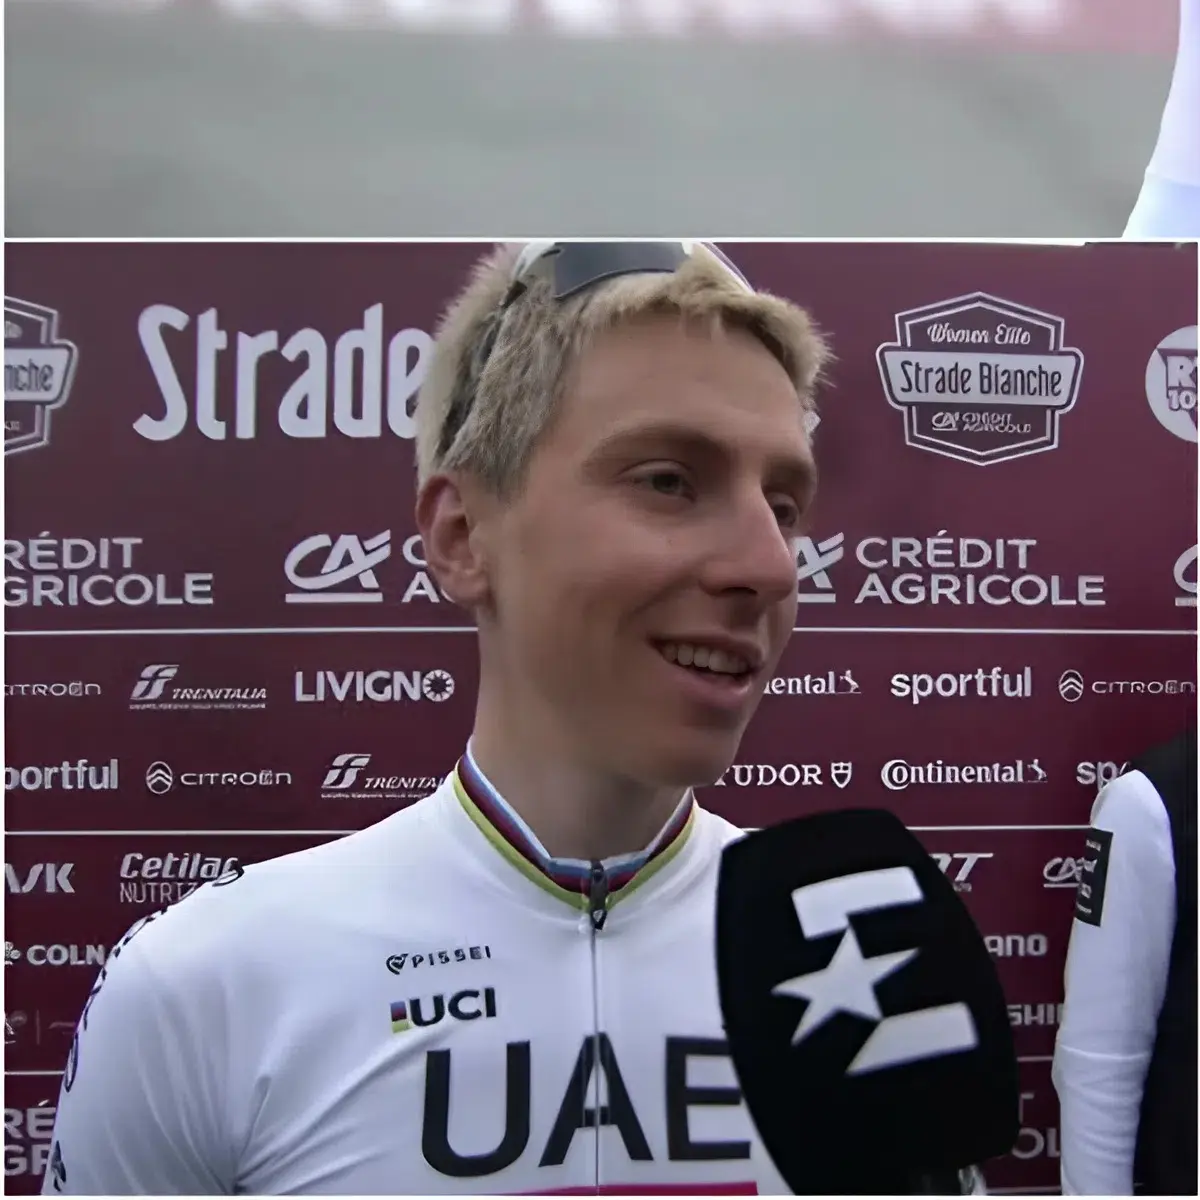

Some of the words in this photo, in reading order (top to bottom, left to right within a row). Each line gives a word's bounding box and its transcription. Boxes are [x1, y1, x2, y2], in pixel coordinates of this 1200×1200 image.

[132, 302, 436, 441] Strade
[900, 360, 972, 394] Strade
[979, 361, 1063, 397] Blanche
[855, 529, 1037, 569] CRÉDIT
[854, 572, 1107, 606] AGRICOLE
[295, 669, 455, 702] LIVIGNO
[889, 666, 1032, 704] sportful
[880, 758, 1024, 791] Continental
[1076, 760, 1129, 792] sp
[411, 944, 492, 970] PISSEI
[408, 986, 497, 1028] UCI
[1007, 1003, 1063, 1027] SHI
[421, 1031, 752, 1178] UAE
